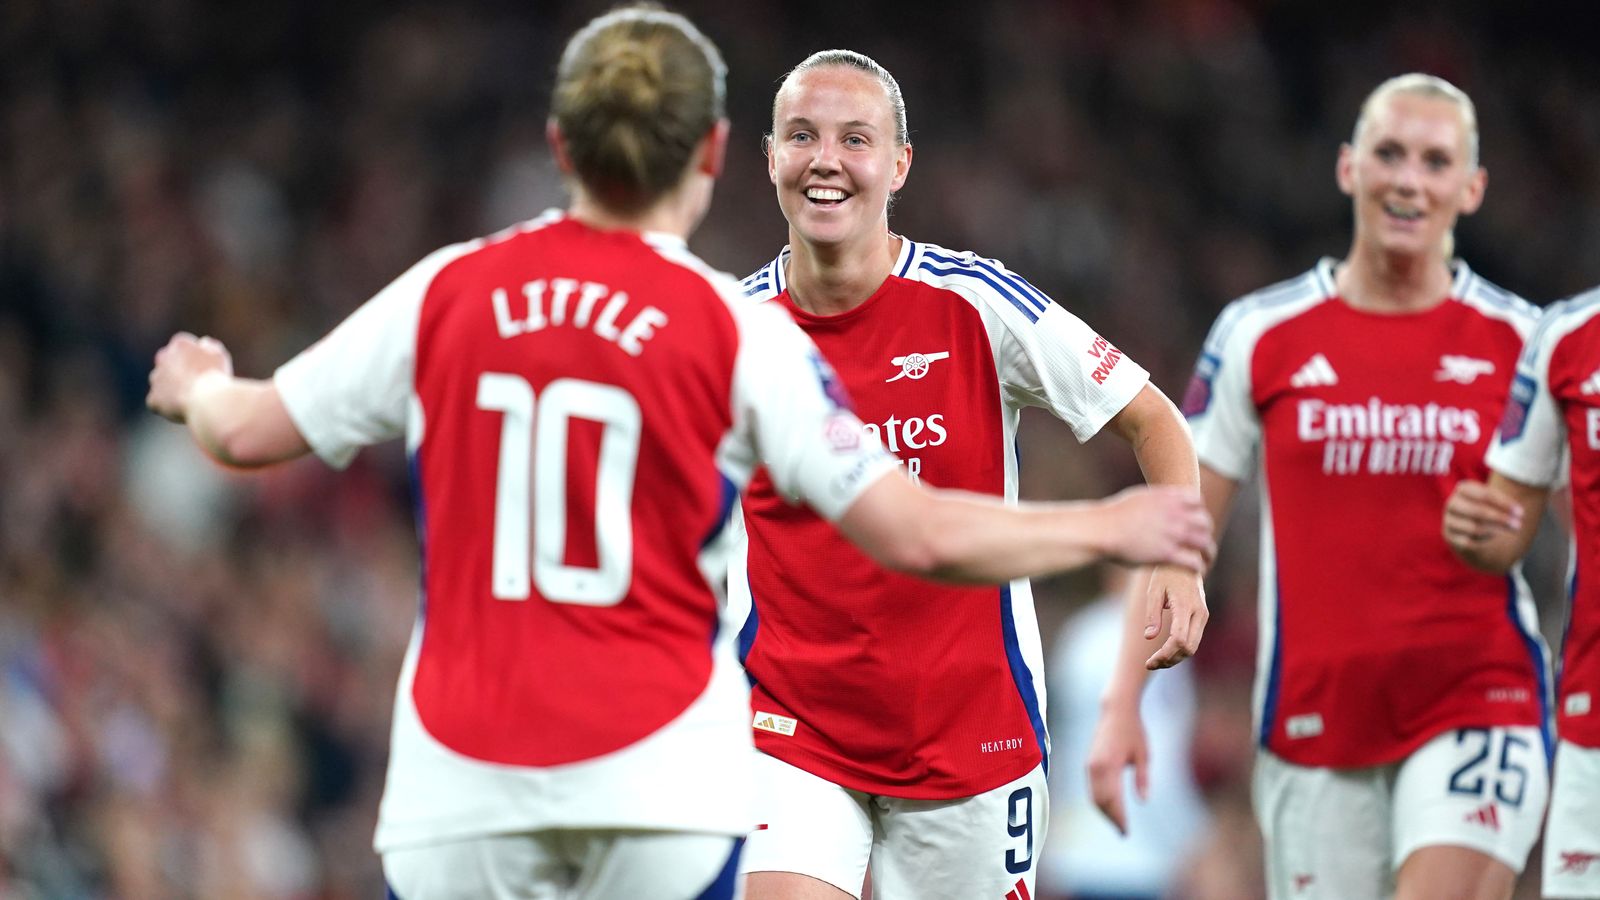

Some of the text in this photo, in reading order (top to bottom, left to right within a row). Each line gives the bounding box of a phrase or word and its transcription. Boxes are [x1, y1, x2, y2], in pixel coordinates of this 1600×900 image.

[491, 277, 669, 357] LITTLE
[1296, 396, 1481, 445] Emirates
[475, 371, 643, 607] 10
[980, 737, 1023, 753] HEAT.RDY
[1448, 726, 1533, 808] 25
[1005, 786, 1033, 875] 9
